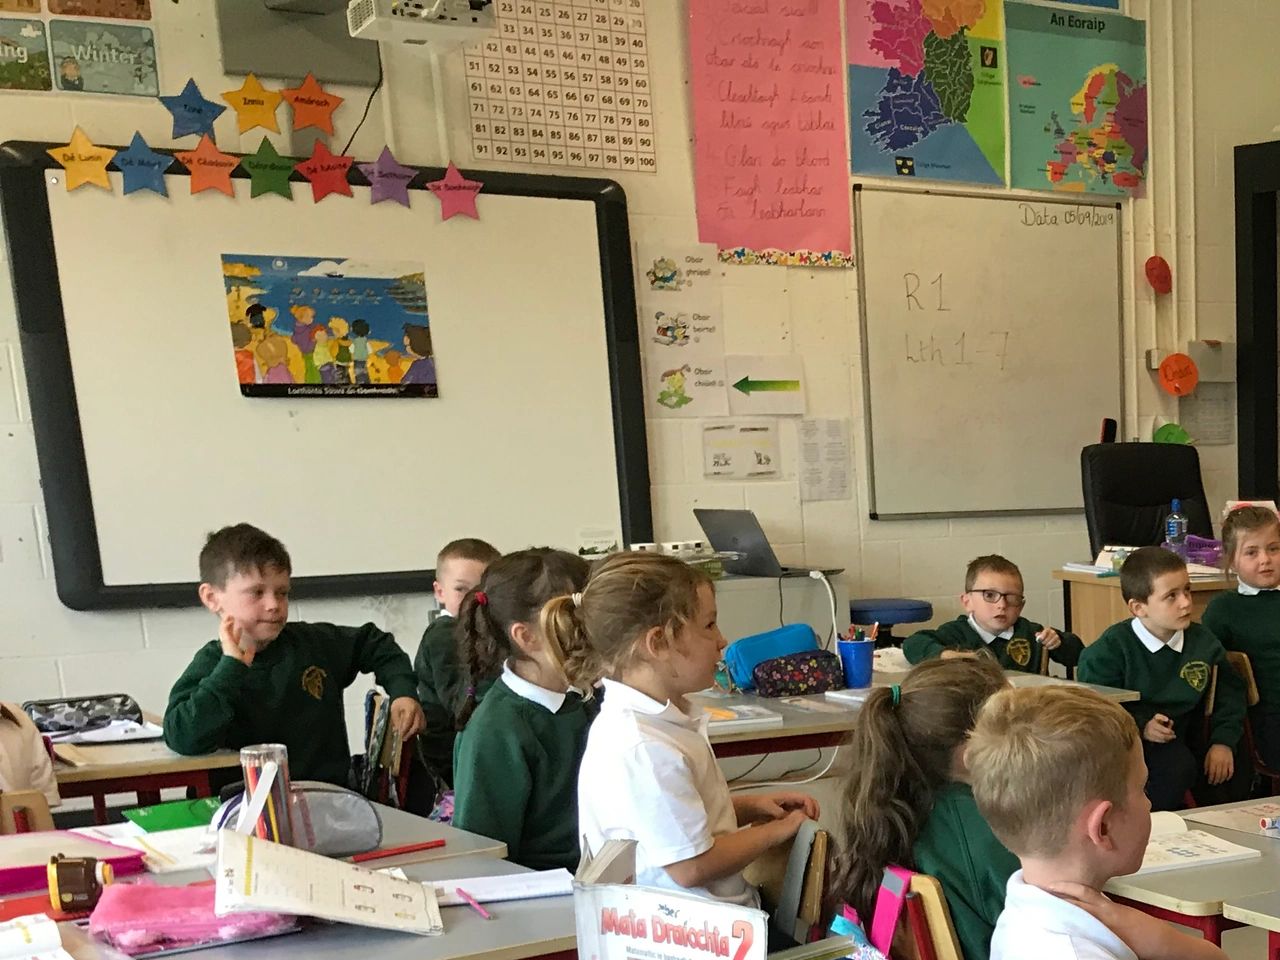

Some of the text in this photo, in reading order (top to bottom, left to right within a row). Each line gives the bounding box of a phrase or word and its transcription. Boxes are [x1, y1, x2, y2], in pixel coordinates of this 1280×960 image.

[1051, 13, 1105, 33] An Eoraip
[72, 44, 139, 64] Winter
[475, 124, 486, 132] 81
[495, 126, 505, 134] 82
[513, 128, 524, 136] 83
[532, 129, 543, 138] 84
[551, 131, 561, 139] 85
[569, 132, 580, 141] 86
[587, 134, 598, 142] 87
[605, 136, 615, 144] 88
[623, 137, 633, 145] 89
[640, 138, 651, 147] 90
[477, 145, 487, 153] 91
[496, 146, 507, 155] 92
[515, 148, 526, 156] 93
[534, 149, 545, 158] 94
[552, 151, 563, 159] 95
[570, 153, 582, 161] 96
[589, 154, 599, 162] 97
[606, 155, 617, 163] 98
[624, 157, 634, 165] 99
[640, 158, 654, 166] 100
[1019, 203, 1114, 227] Data 05/09/2019
[904, 272, 951, 311] R 1
[601, 907, 647, 939] Mata
[651, 915, 730, 958] Draíochta
